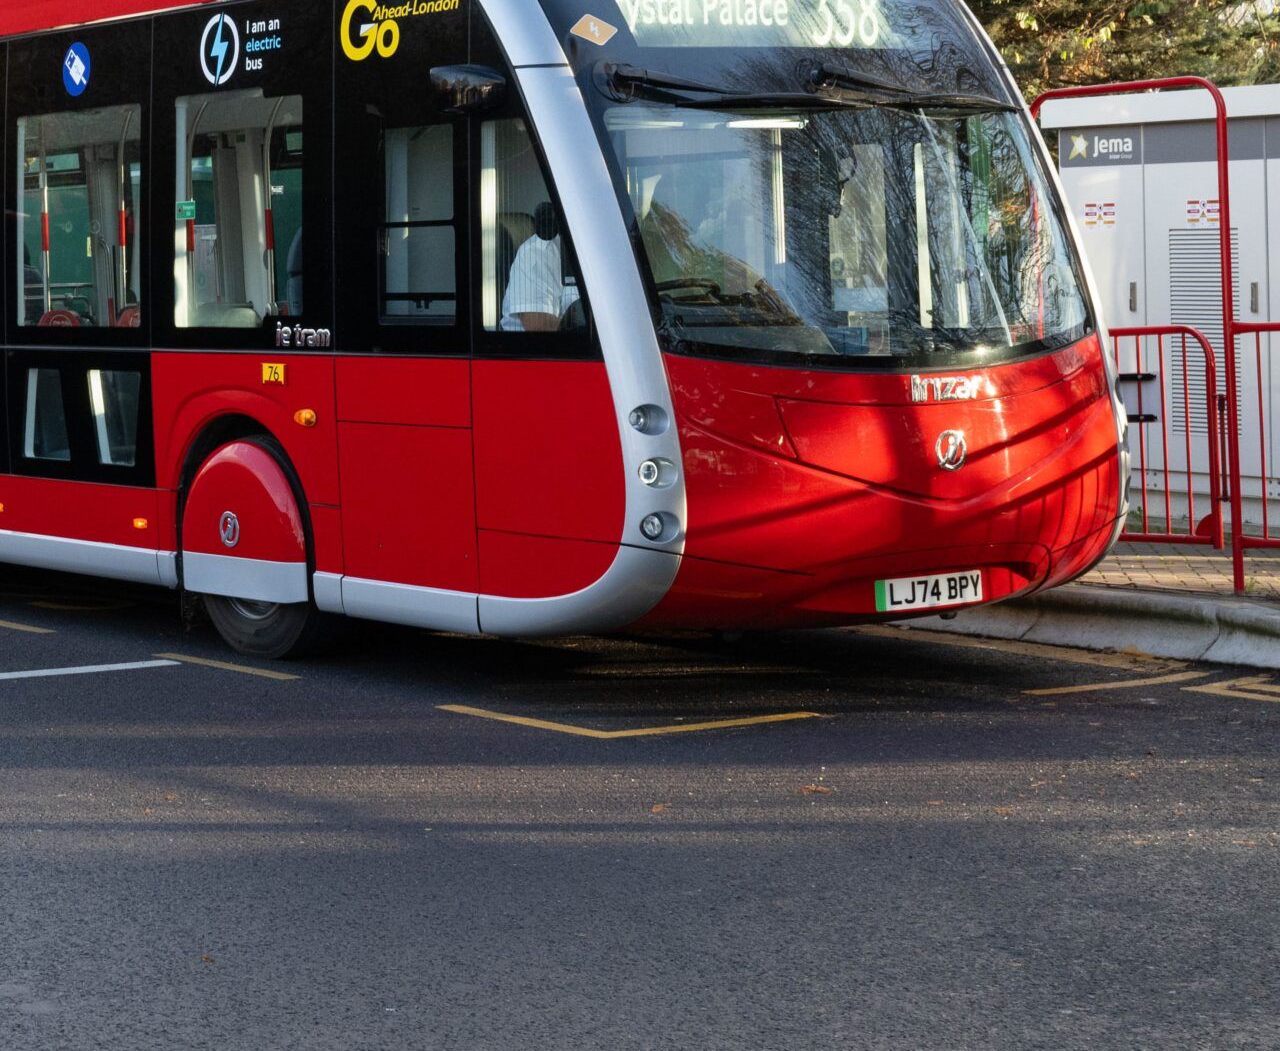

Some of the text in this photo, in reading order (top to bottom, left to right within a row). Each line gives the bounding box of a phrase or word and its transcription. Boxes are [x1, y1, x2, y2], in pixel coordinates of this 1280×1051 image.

[251, 20, 266, 34] am
[268, 18, 280, 31] an
[246, 34, 281, 53] electric
[245, 57, 263, 71] bus
[1093, 135, 1133, 158] Jema
[294, 323, 331, 347] tram
[268, 366, 280, 381] 76
[889, 574, 980, 606] LJ74 BPY
